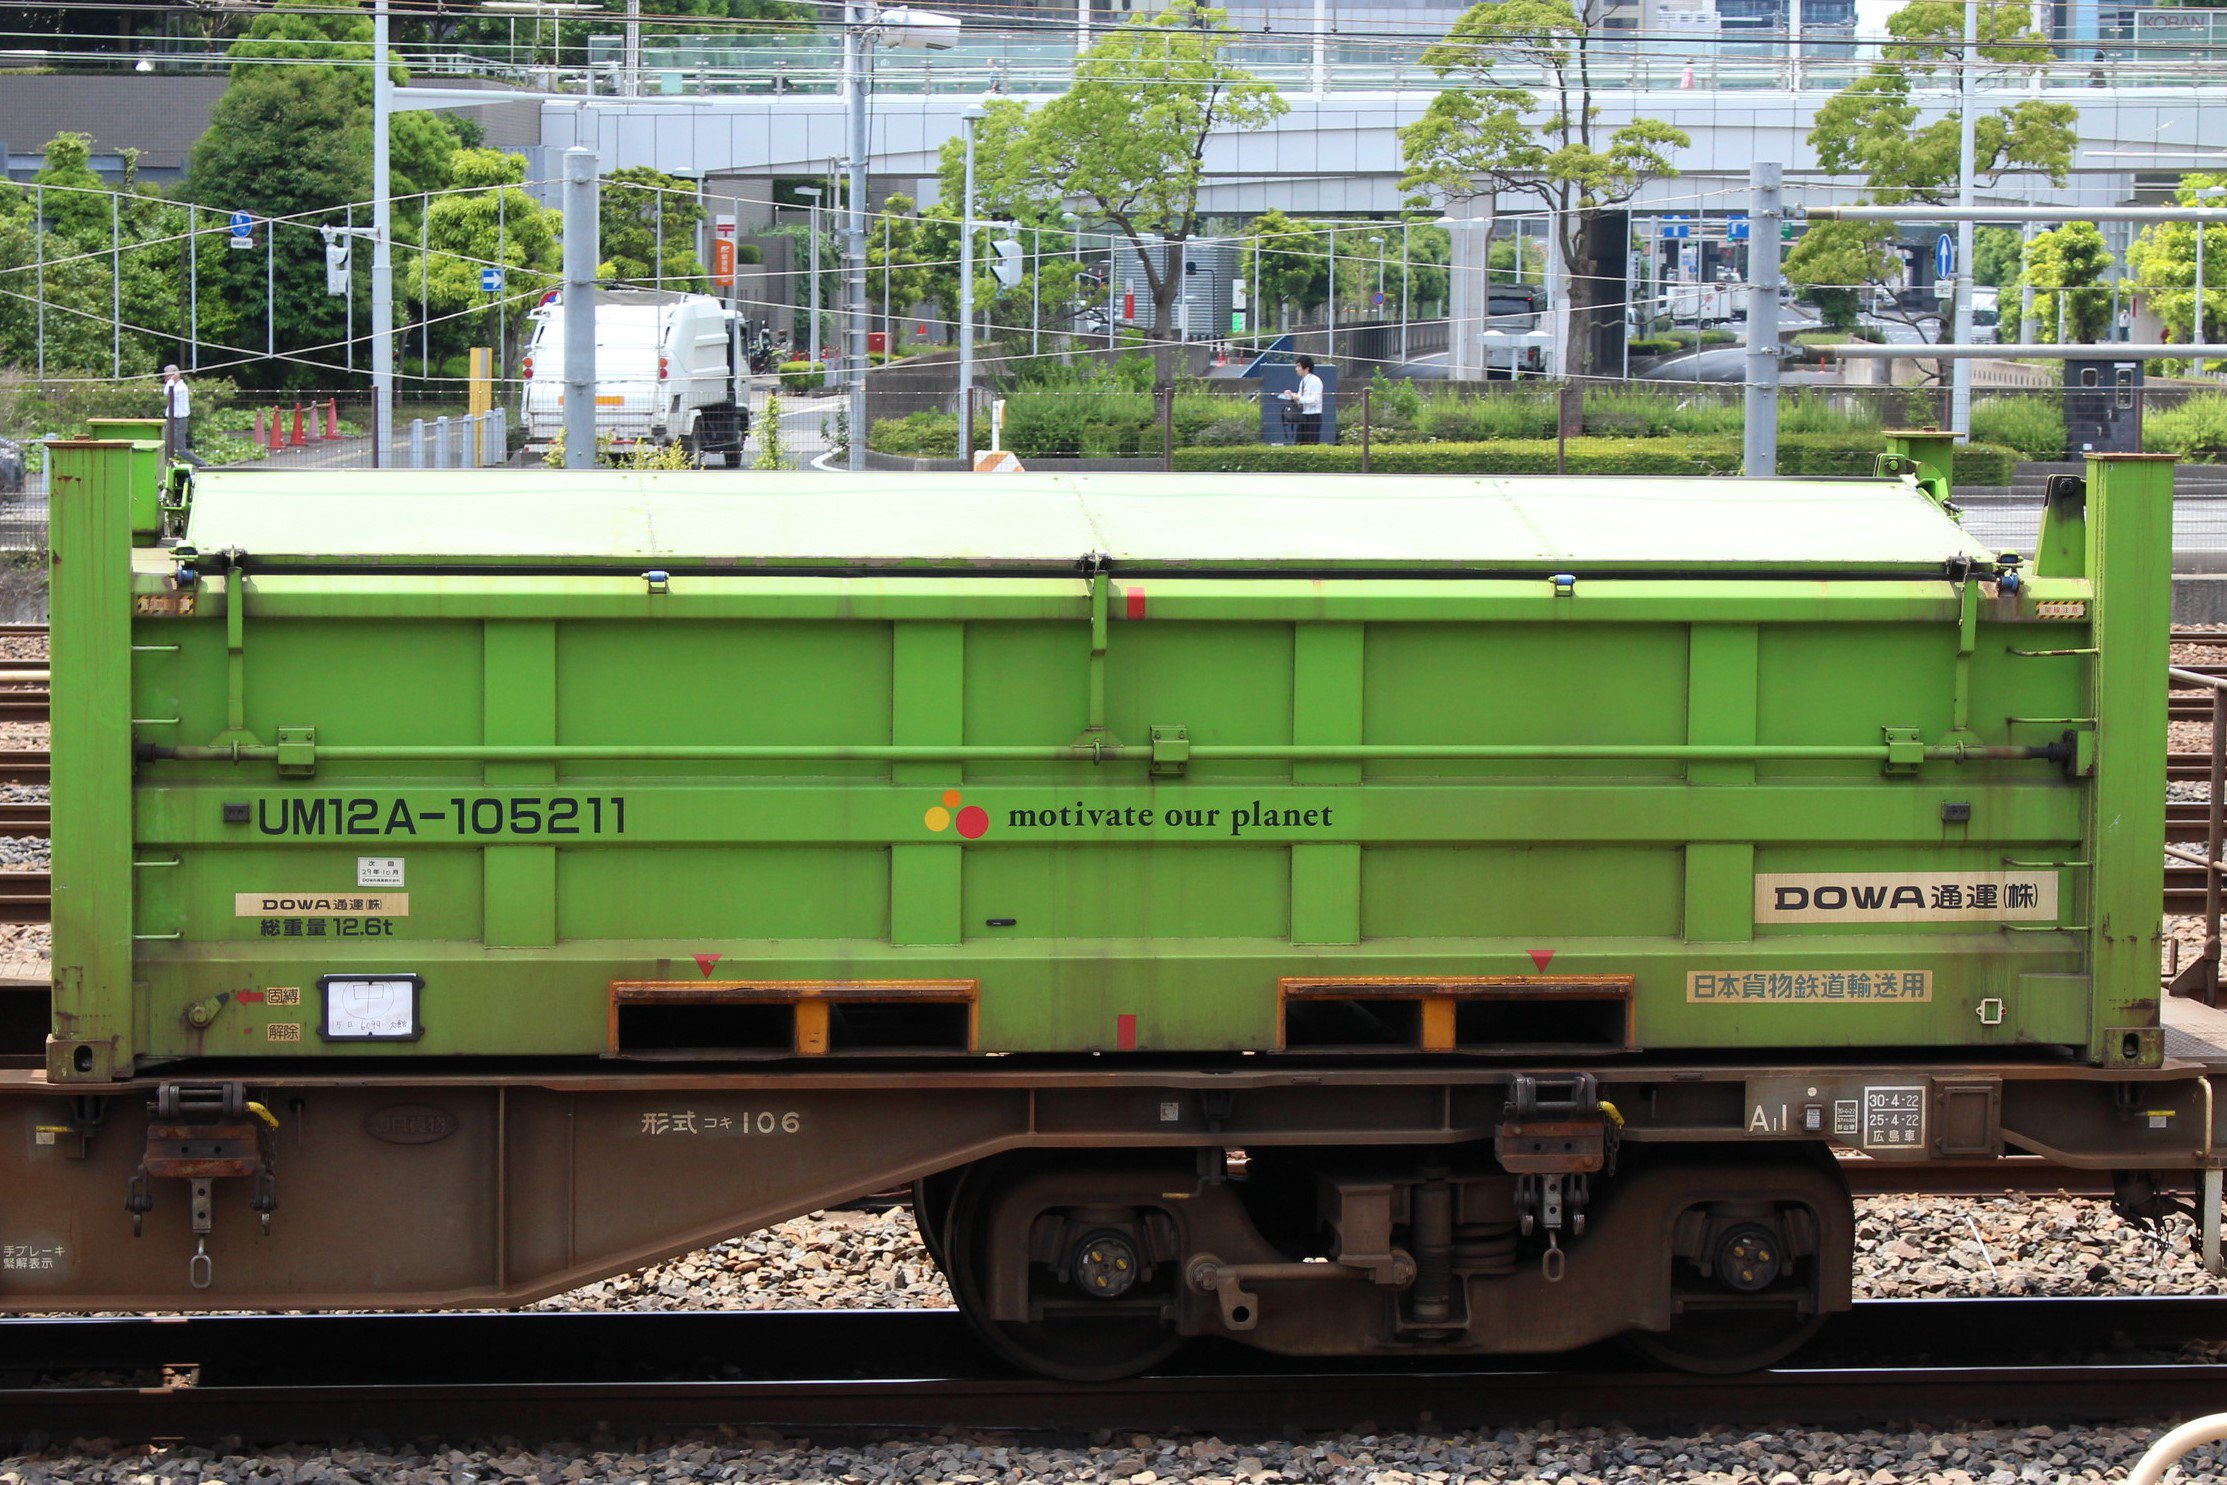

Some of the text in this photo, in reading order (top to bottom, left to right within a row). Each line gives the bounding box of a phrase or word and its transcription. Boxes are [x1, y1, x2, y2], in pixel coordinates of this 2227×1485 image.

[2143, 15, 2204, 30] KOBAN
[258, 797, 625, 836] UM12A-105211
[1008, 799, 1333, 836] motivate our planet
[1694, 972, 1925, 999] 日本貨物鉄道輸送用
[268, 1024, 299, 1040] 解除
[1873, 1129, 1915, 1142] 広島車
